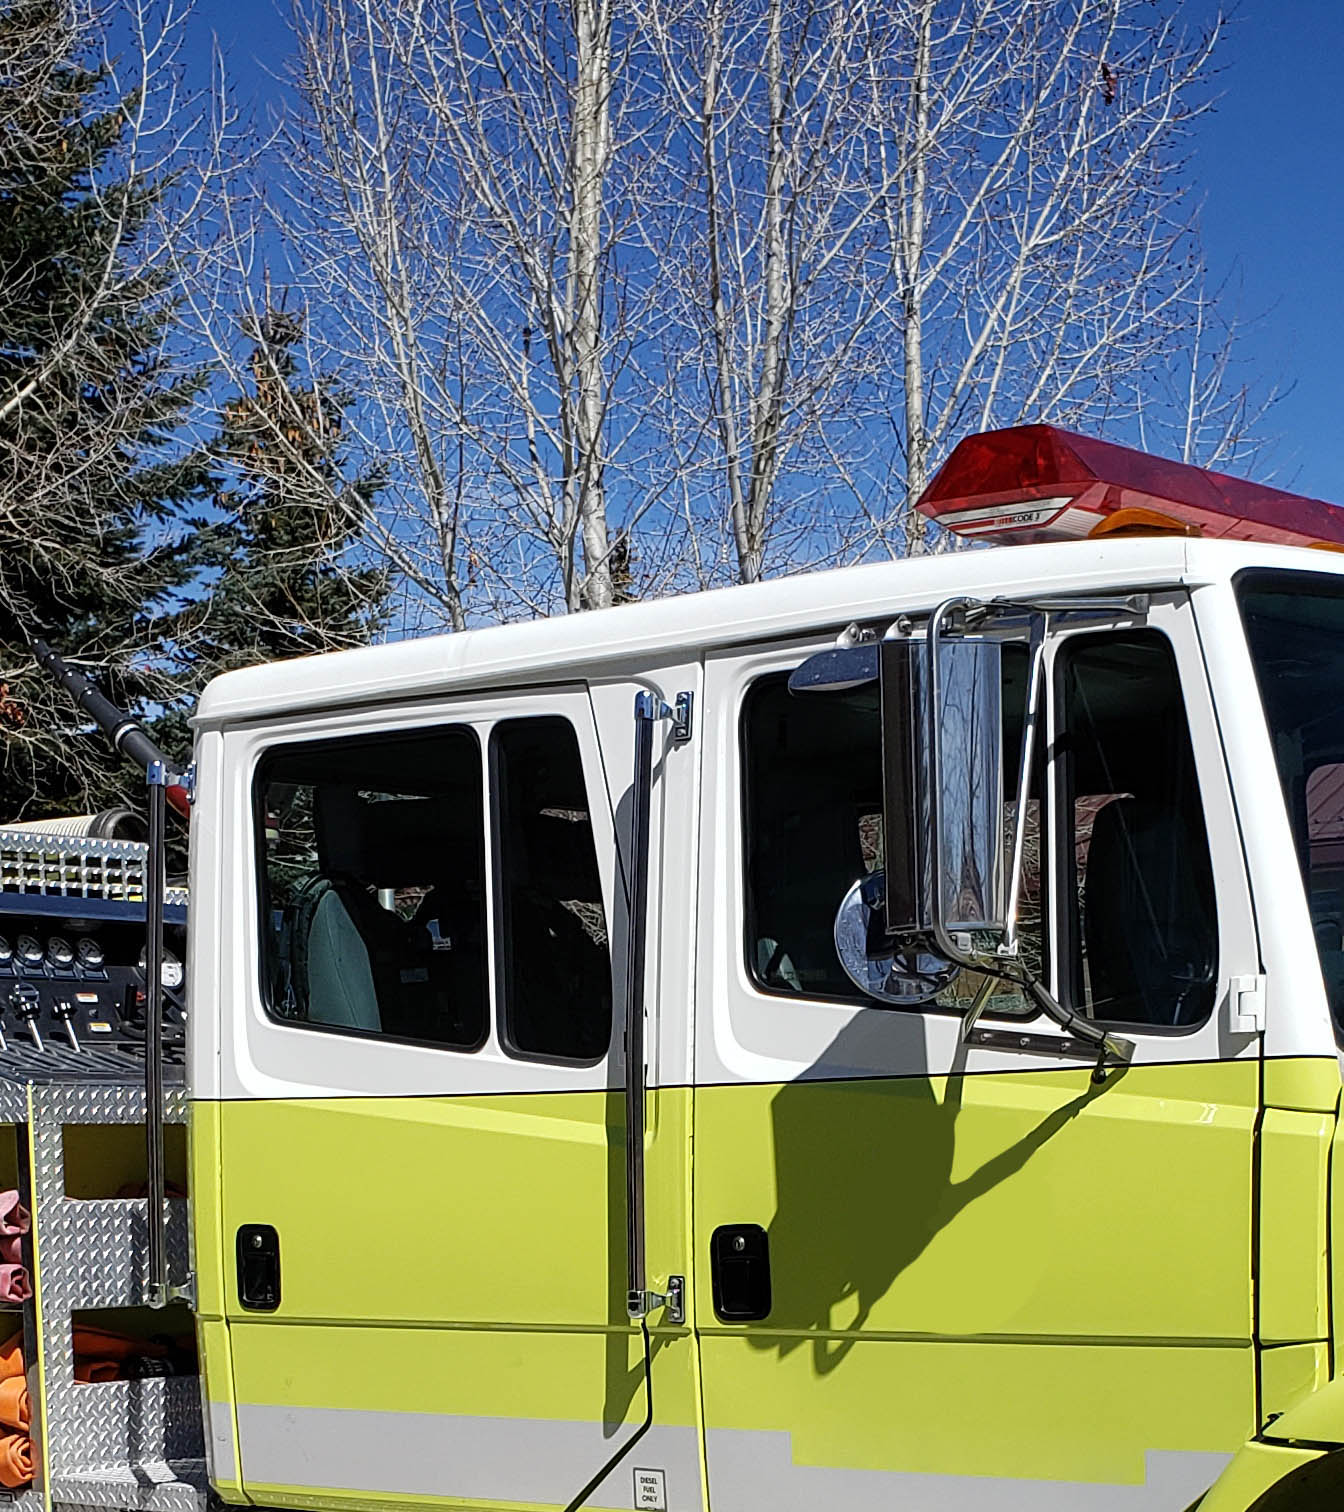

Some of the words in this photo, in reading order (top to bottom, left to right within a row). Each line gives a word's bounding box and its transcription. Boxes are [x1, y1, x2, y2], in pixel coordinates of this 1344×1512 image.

[1012, 512, 1034, 523] CODE
[640, 1476, 658, 1485] DIESEL
[643, 1486, 656, 1494] FUEL
[642, 1495, 657, 1503] ONLY
